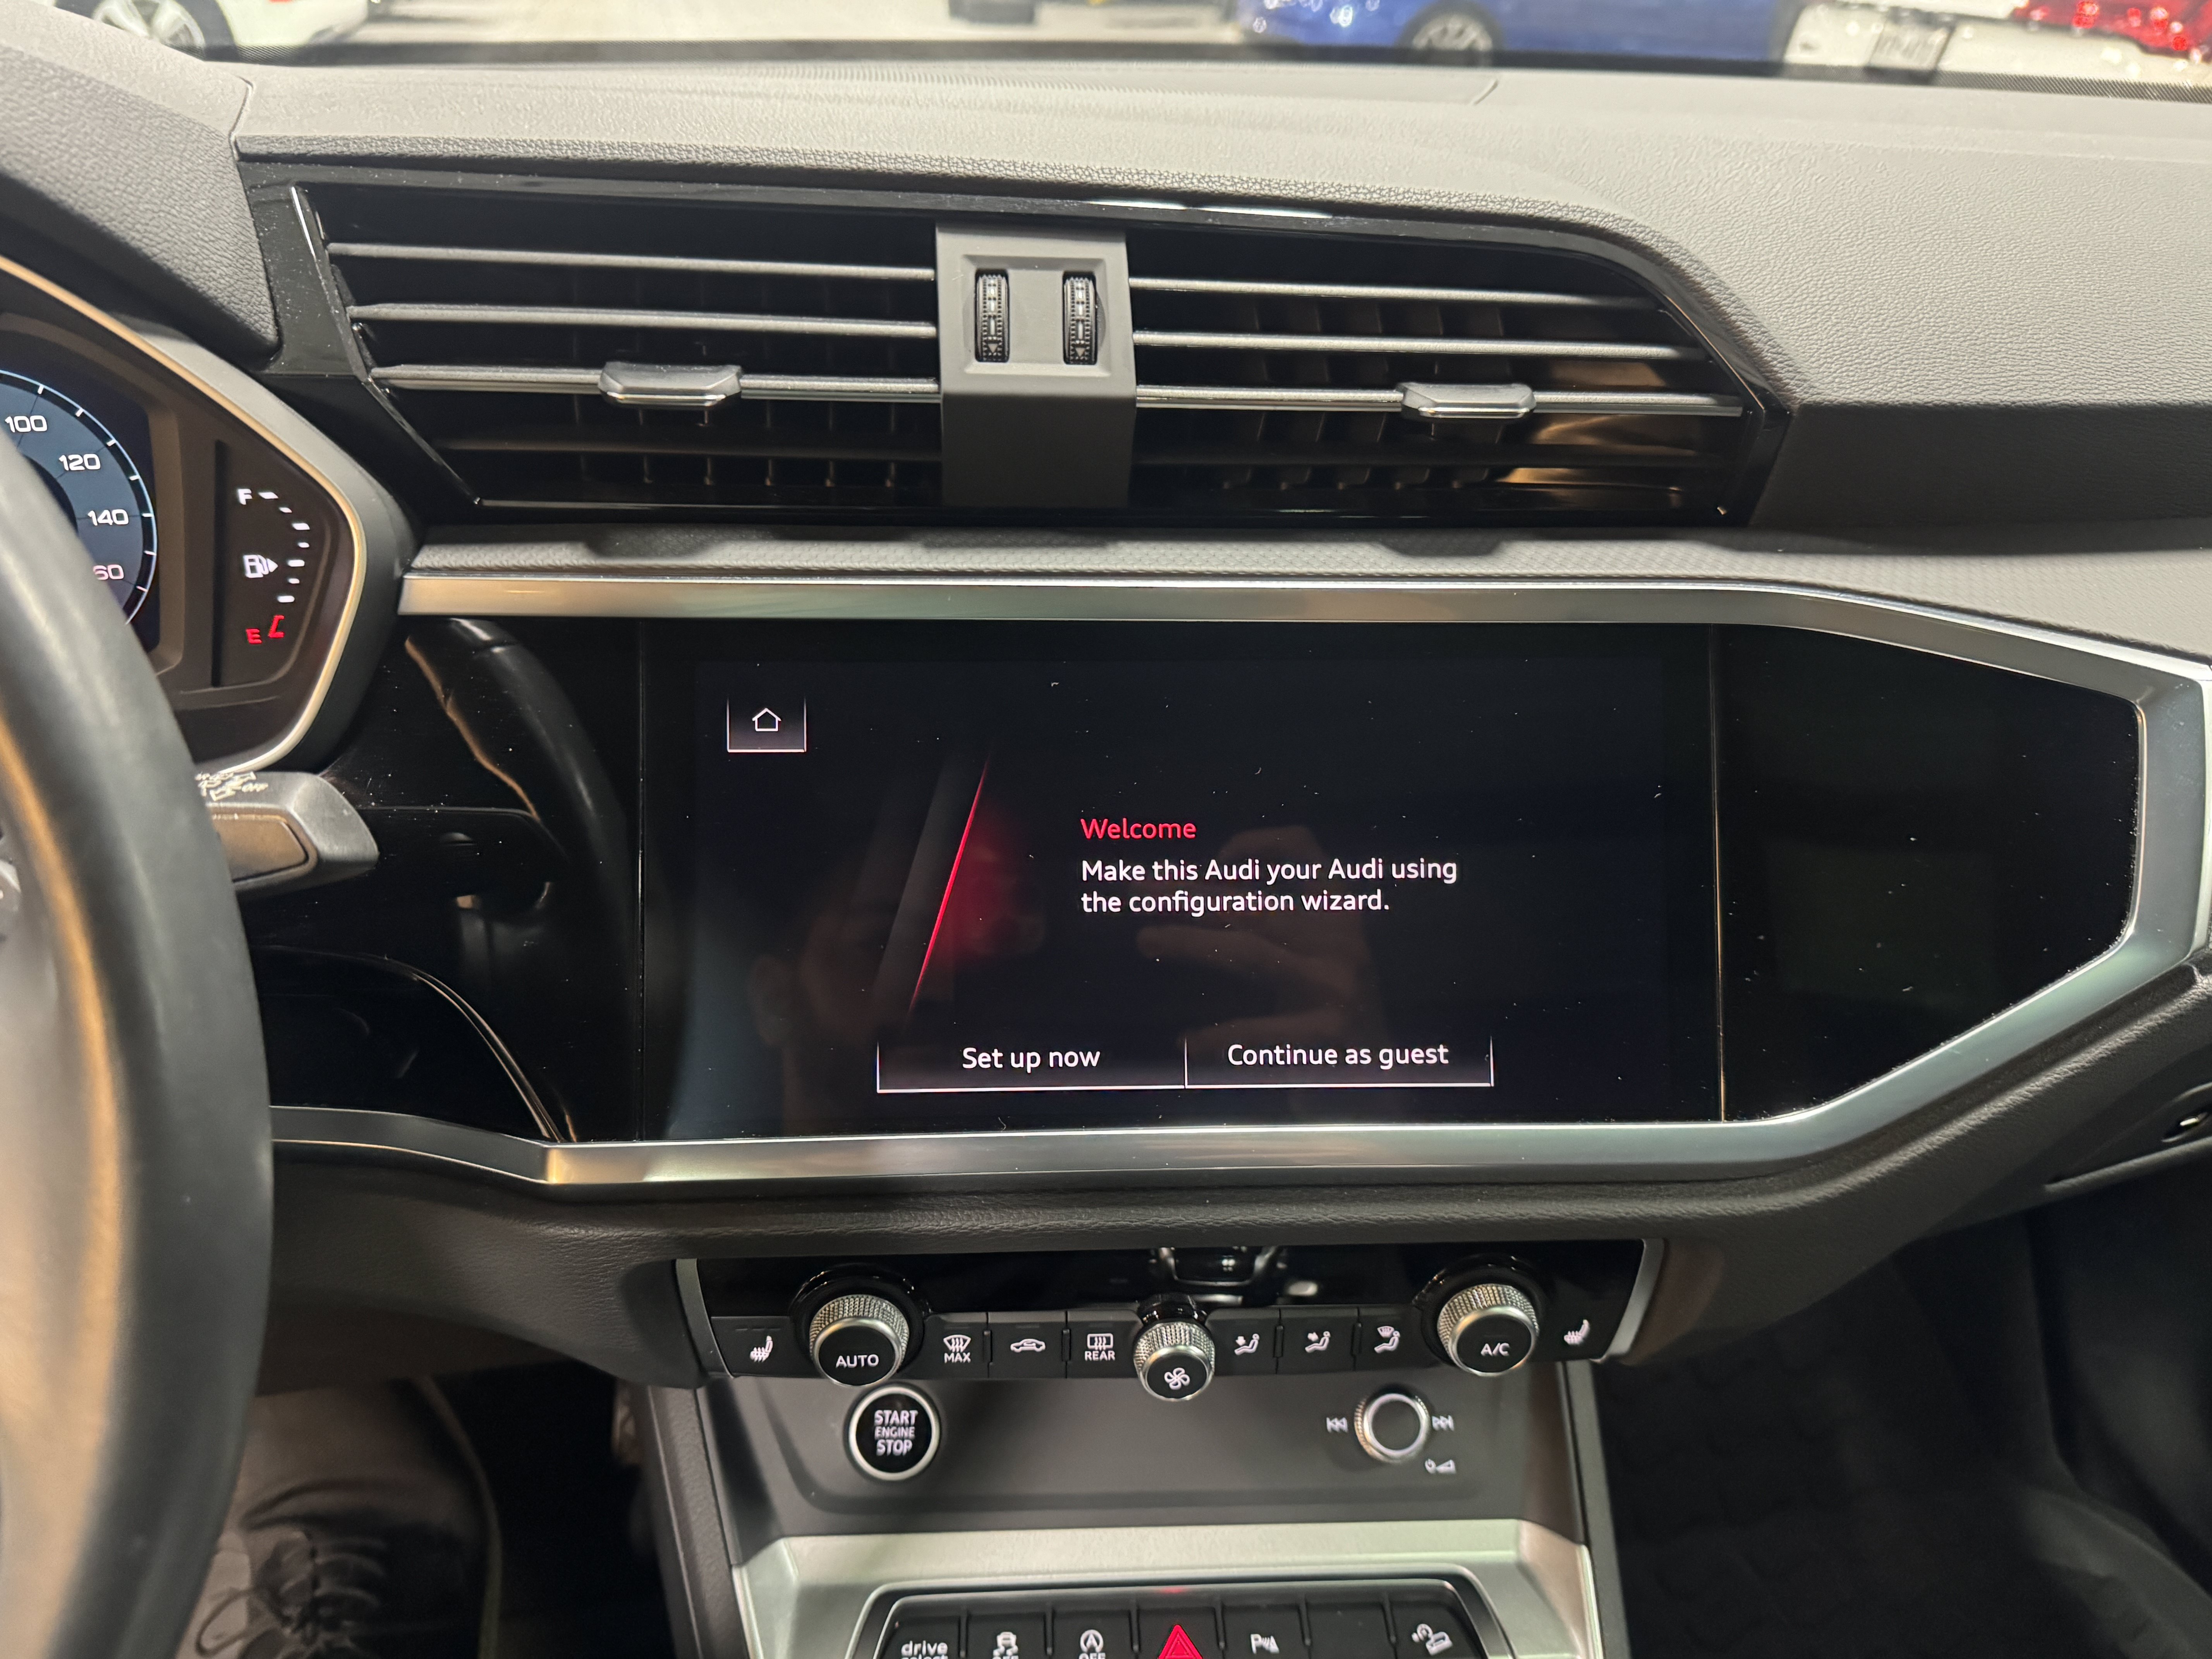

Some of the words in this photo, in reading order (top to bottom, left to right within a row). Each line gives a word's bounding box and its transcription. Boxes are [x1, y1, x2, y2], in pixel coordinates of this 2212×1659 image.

[5, 415, 47, 433] 100
[58, 453, 101, 471] 120
[237, 488, 252, 505] F
[87, 509, 129, 526] 140
[93, 564, 124, 580] 60
[246, 628, 262, 644] E
[1080, 817, 1197, 840] Welcome
[1082, 859, 1146, 881] Make
[1152, 859, 1198, 881] this
[1205, 858, 1259, 880] Audi
[1266, 859, 1322, 885] your
[1328, 857, 1383, 879] Audi
[1392, 858, 1457, 884] using
[1081, 891, 1121, 912] the
[1129, 890, 1294, 917] configuration
[1301, 889, 1389, 911] wizard.
[962, 1047, 1003, 1069] Set
[1011, 1052, 1041, 1073] up
[1049, 1051, 1101, 1068] now
[1228, 1043, 1338, 1066] Continue
[1345, 1048, 1372, 1065] as
[1379, 1044, 1449, 1070] guest
[1084, 1350, 1116, 1361] REAR
[1480, 1342, 1510, 1356] A/C
[836, 1353, 879, 1367] AUTO
[944, 1352, 971, 1364] MAX
[874, 1410, 918, 1426] START
[874, 1426, 915, 1439] ENGINE
[876, 1439, 913, 1456] STOP
[901, 1640, 948, 1656] drive
